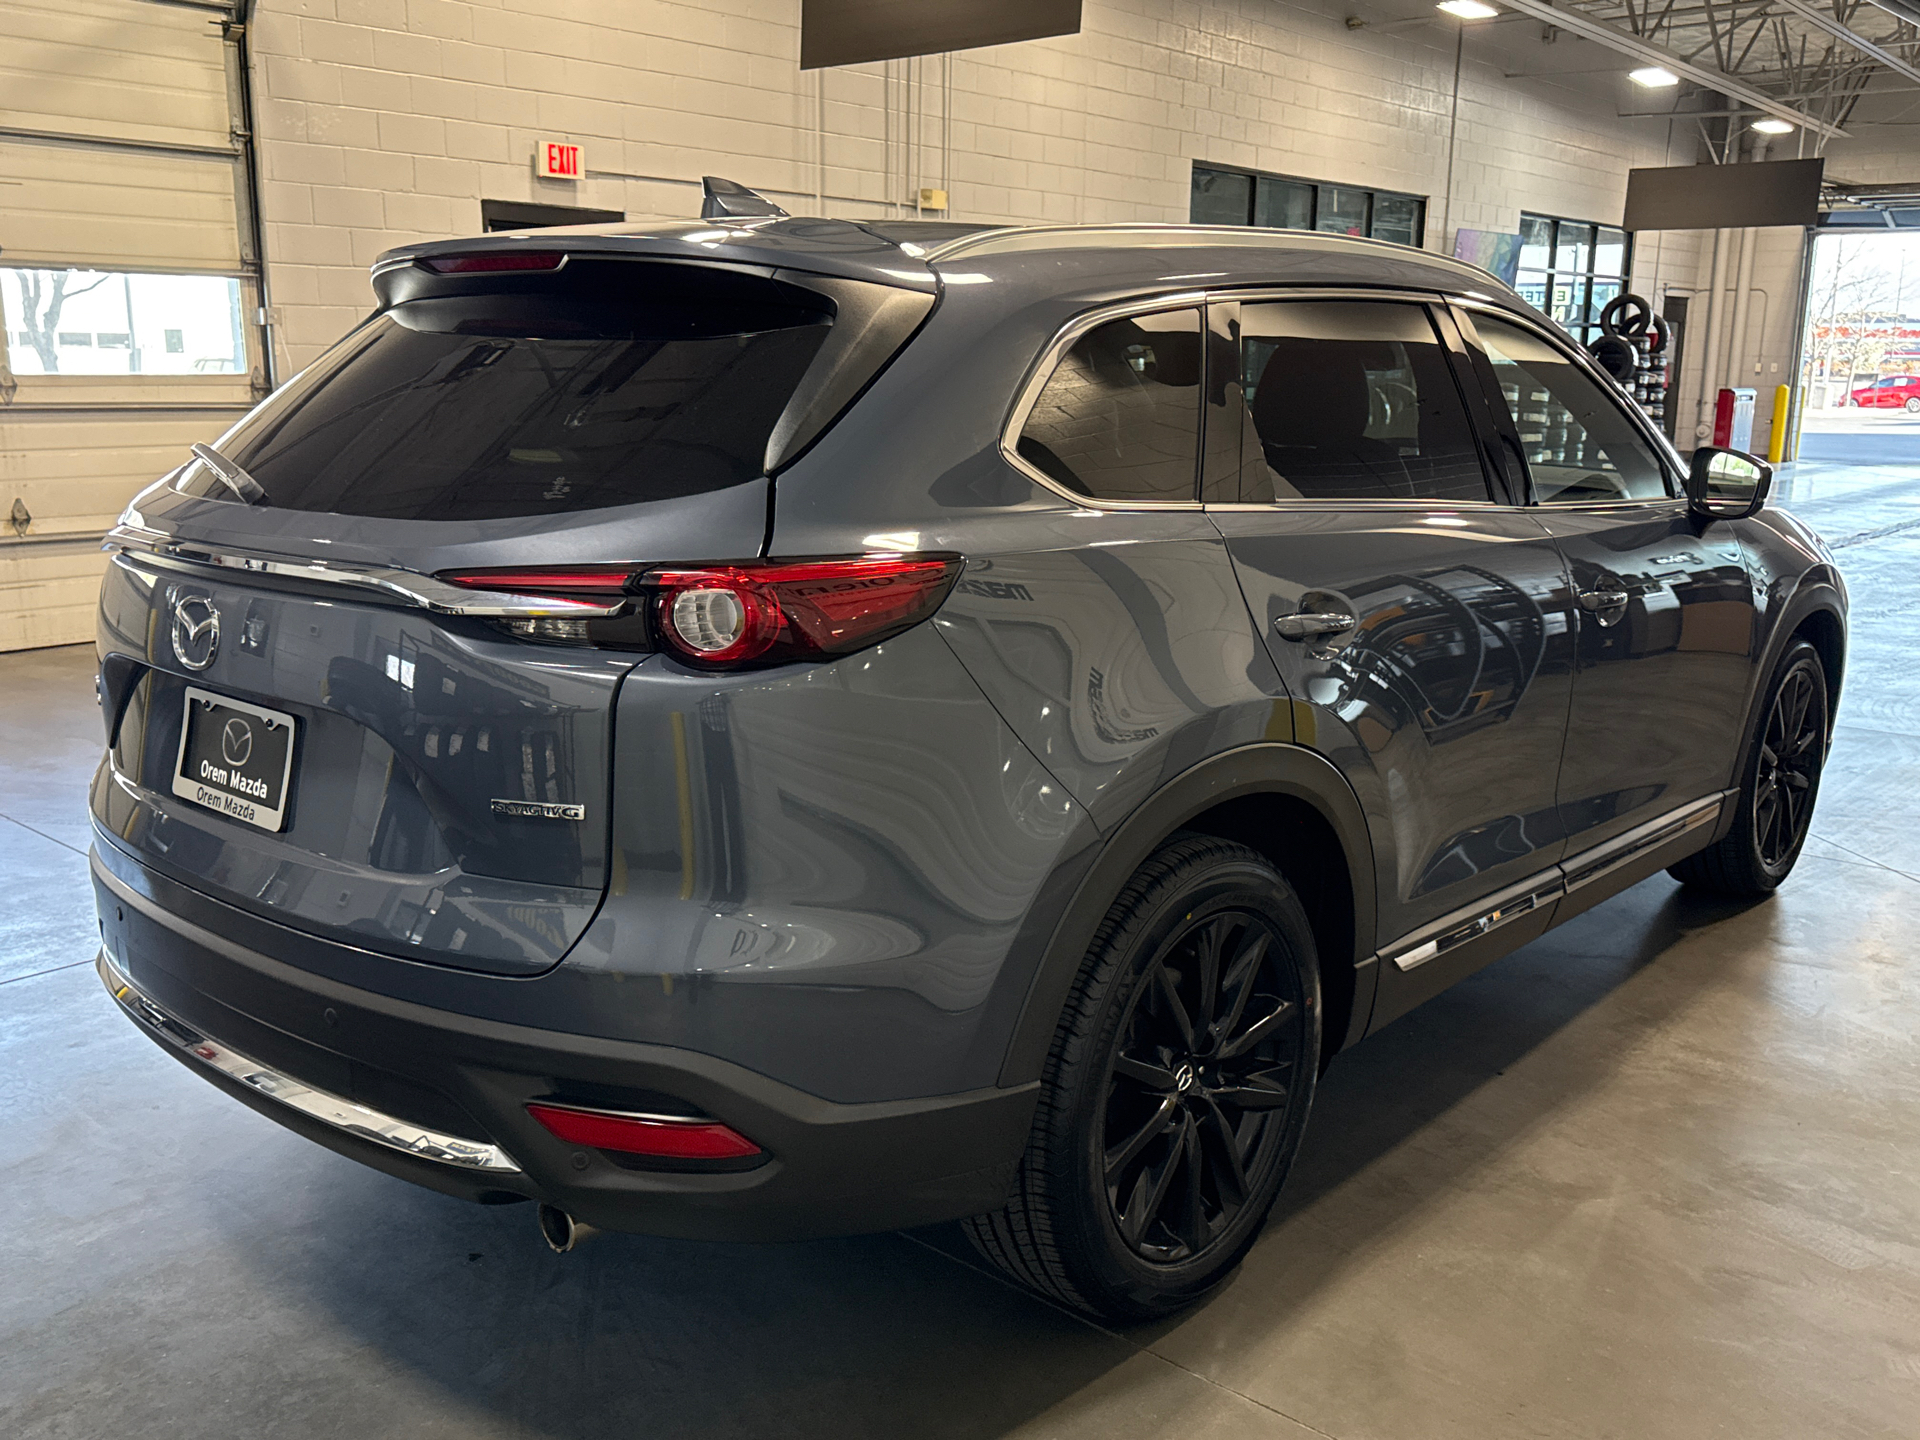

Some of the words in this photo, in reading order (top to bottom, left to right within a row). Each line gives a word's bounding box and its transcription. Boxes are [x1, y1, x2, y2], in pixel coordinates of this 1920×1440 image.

[548, 143, 578, 175] EXIT
[201, 759, 228, 785] Orem
[231, 770, 268, 799] Mazda
[196, 786, 222, 808] Orem
[224, 797, 255, 821] Mazda
